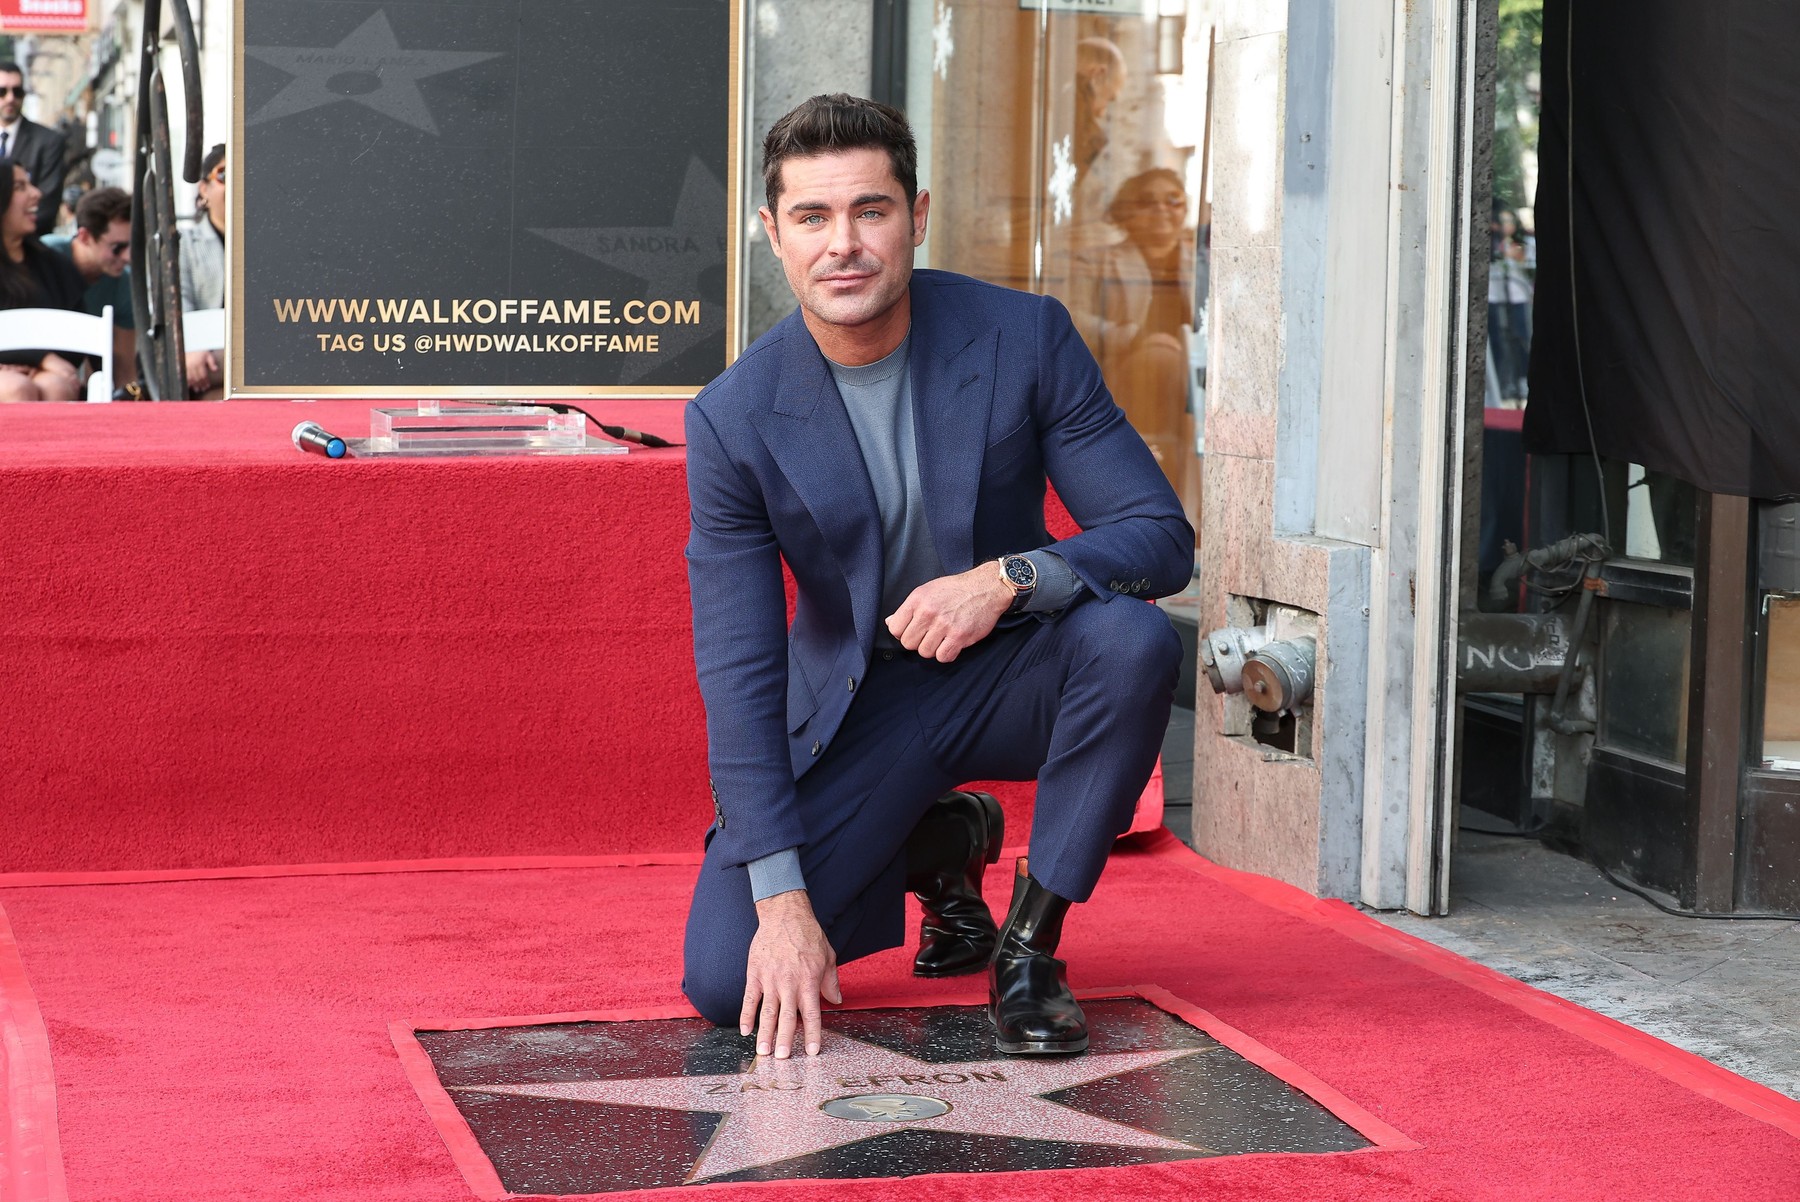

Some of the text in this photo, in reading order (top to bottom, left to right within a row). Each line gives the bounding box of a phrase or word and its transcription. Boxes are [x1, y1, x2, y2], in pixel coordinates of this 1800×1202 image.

[296, 54, 357, 65] MARIO
[597, 236, 700, 253] SANDRA
[273, 298, 701, 325] WWW.WALKOFFAME.COM
[316, 333, 660, 354] TAG US @HWDWALKOFFAME
[835, 1070, 1008, 1088] EFRON
